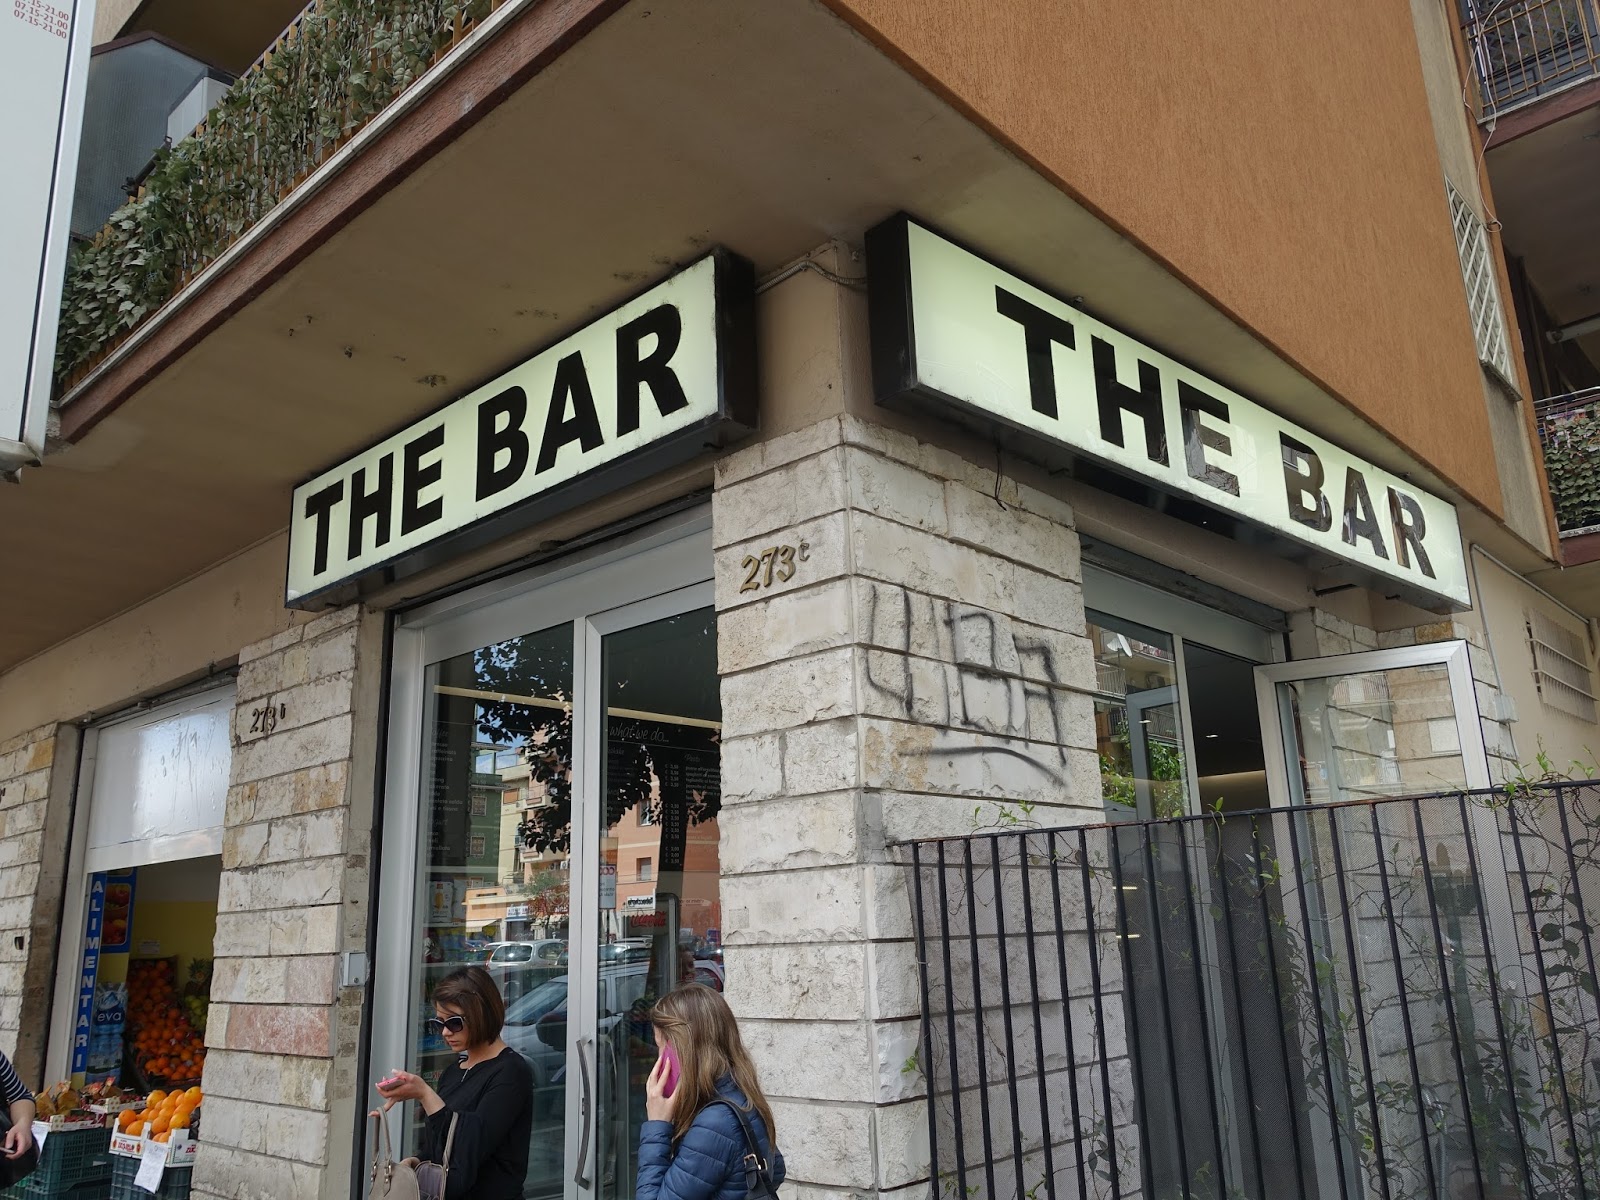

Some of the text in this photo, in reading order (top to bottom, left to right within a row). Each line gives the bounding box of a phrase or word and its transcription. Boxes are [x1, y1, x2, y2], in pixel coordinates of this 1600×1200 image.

[13, 9, 67, 39] 07.15-21.00
[14, 0, 68, 30] 07.15-21.00
[305, 303, 689, 577] THE BAR
[995, 284, 1437, 580] THE BAR
[75, 879, 104, 1069] ALIMENTARI
[97, 1011, 122, 1023] eva
